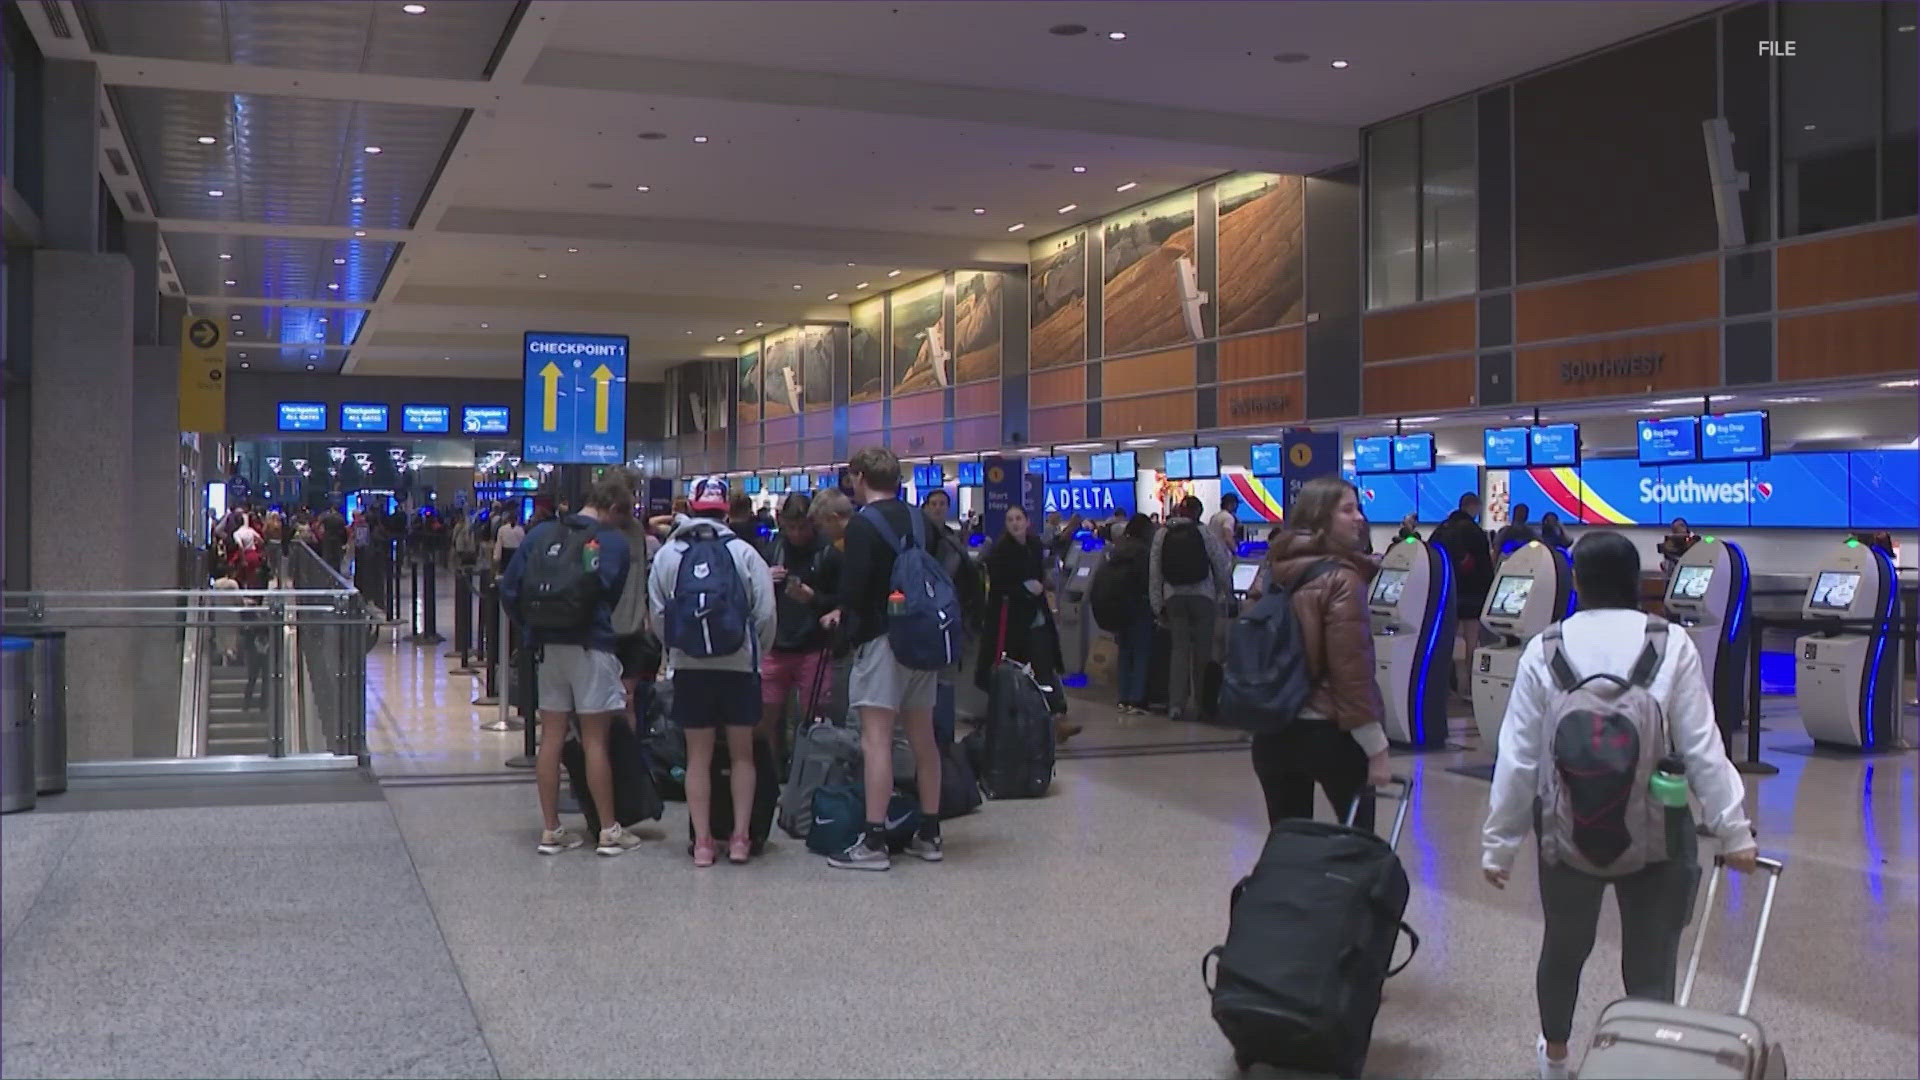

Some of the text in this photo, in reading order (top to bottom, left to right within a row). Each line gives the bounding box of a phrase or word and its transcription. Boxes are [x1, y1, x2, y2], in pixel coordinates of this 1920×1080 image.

[529, 341, 625, 356] CHECKPOINT 1
[1560, 353, 1665, 382] SOUTHWEST
[1060, 487, 1115, 509] DELTA
[1639, 476, 1755, 503] Southwest
